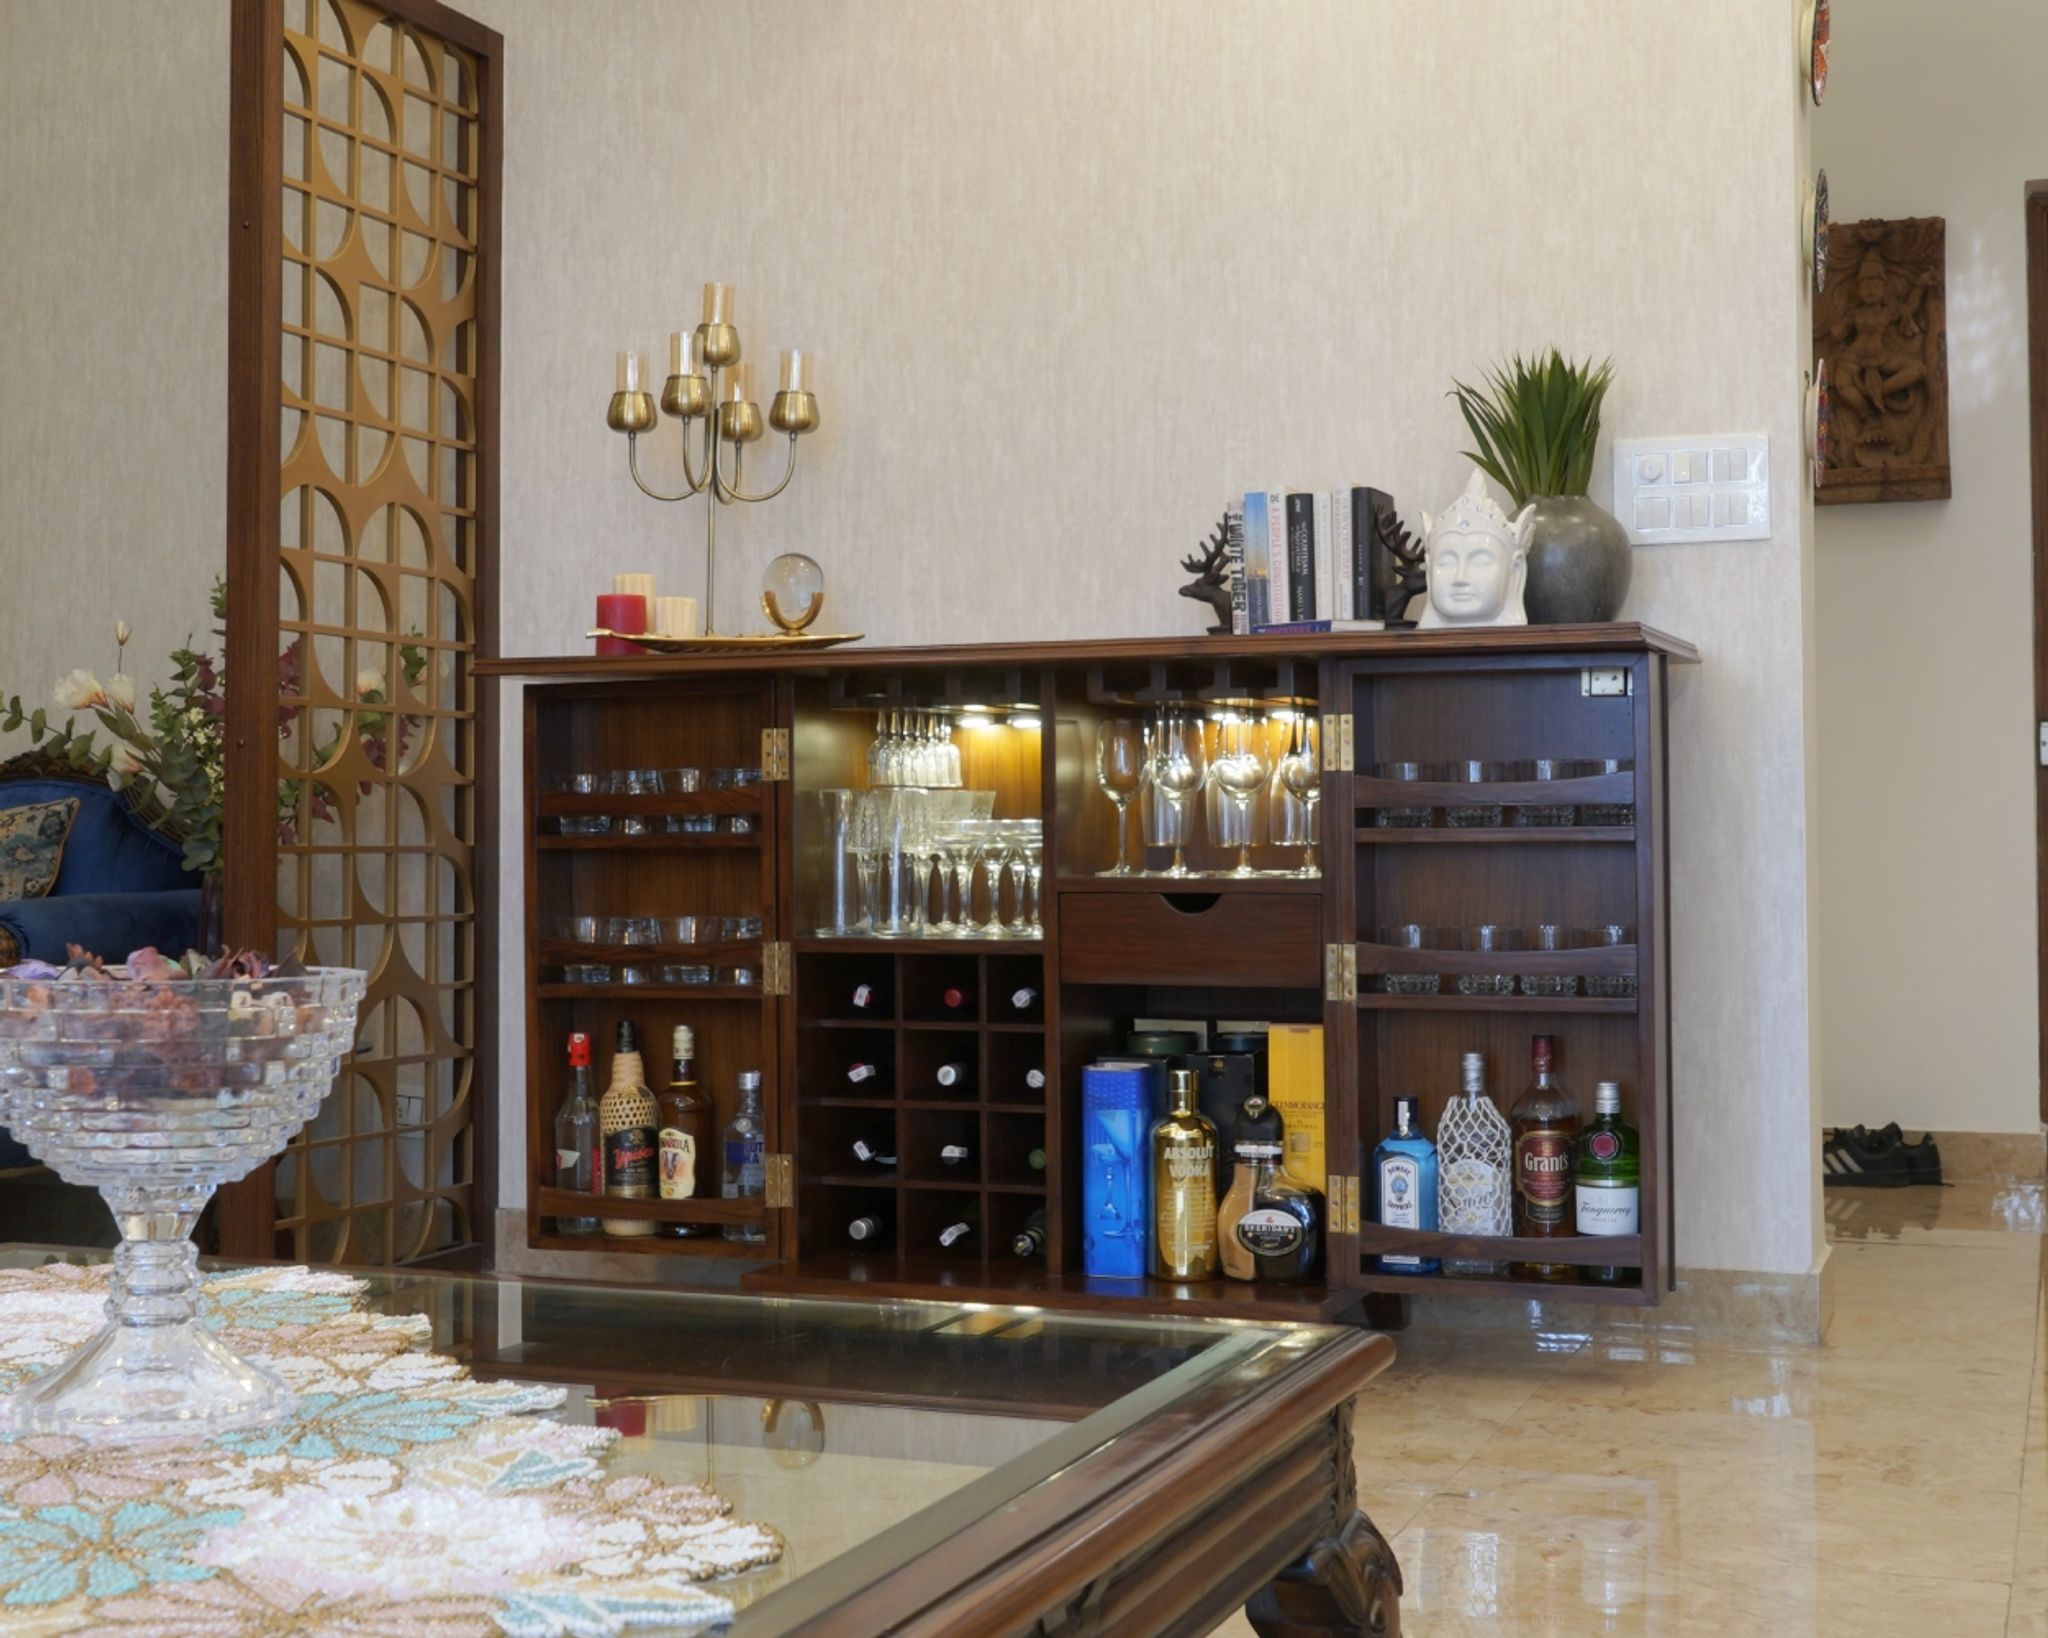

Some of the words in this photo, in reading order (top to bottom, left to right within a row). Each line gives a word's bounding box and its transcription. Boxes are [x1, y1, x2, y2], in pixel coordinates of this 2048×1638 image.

[1228, 523, 1245, 564] WHITE
[1231, 566, 1247, 612] TIGER
[1163, 1145, 1214, 1160] ABSOLUT
[1169, 1163, 1210, 1179] VODKA
[1524, 1152, 1569, 1172] Grant's
[1581, 1200, 1632, 1217] Tanqueray
